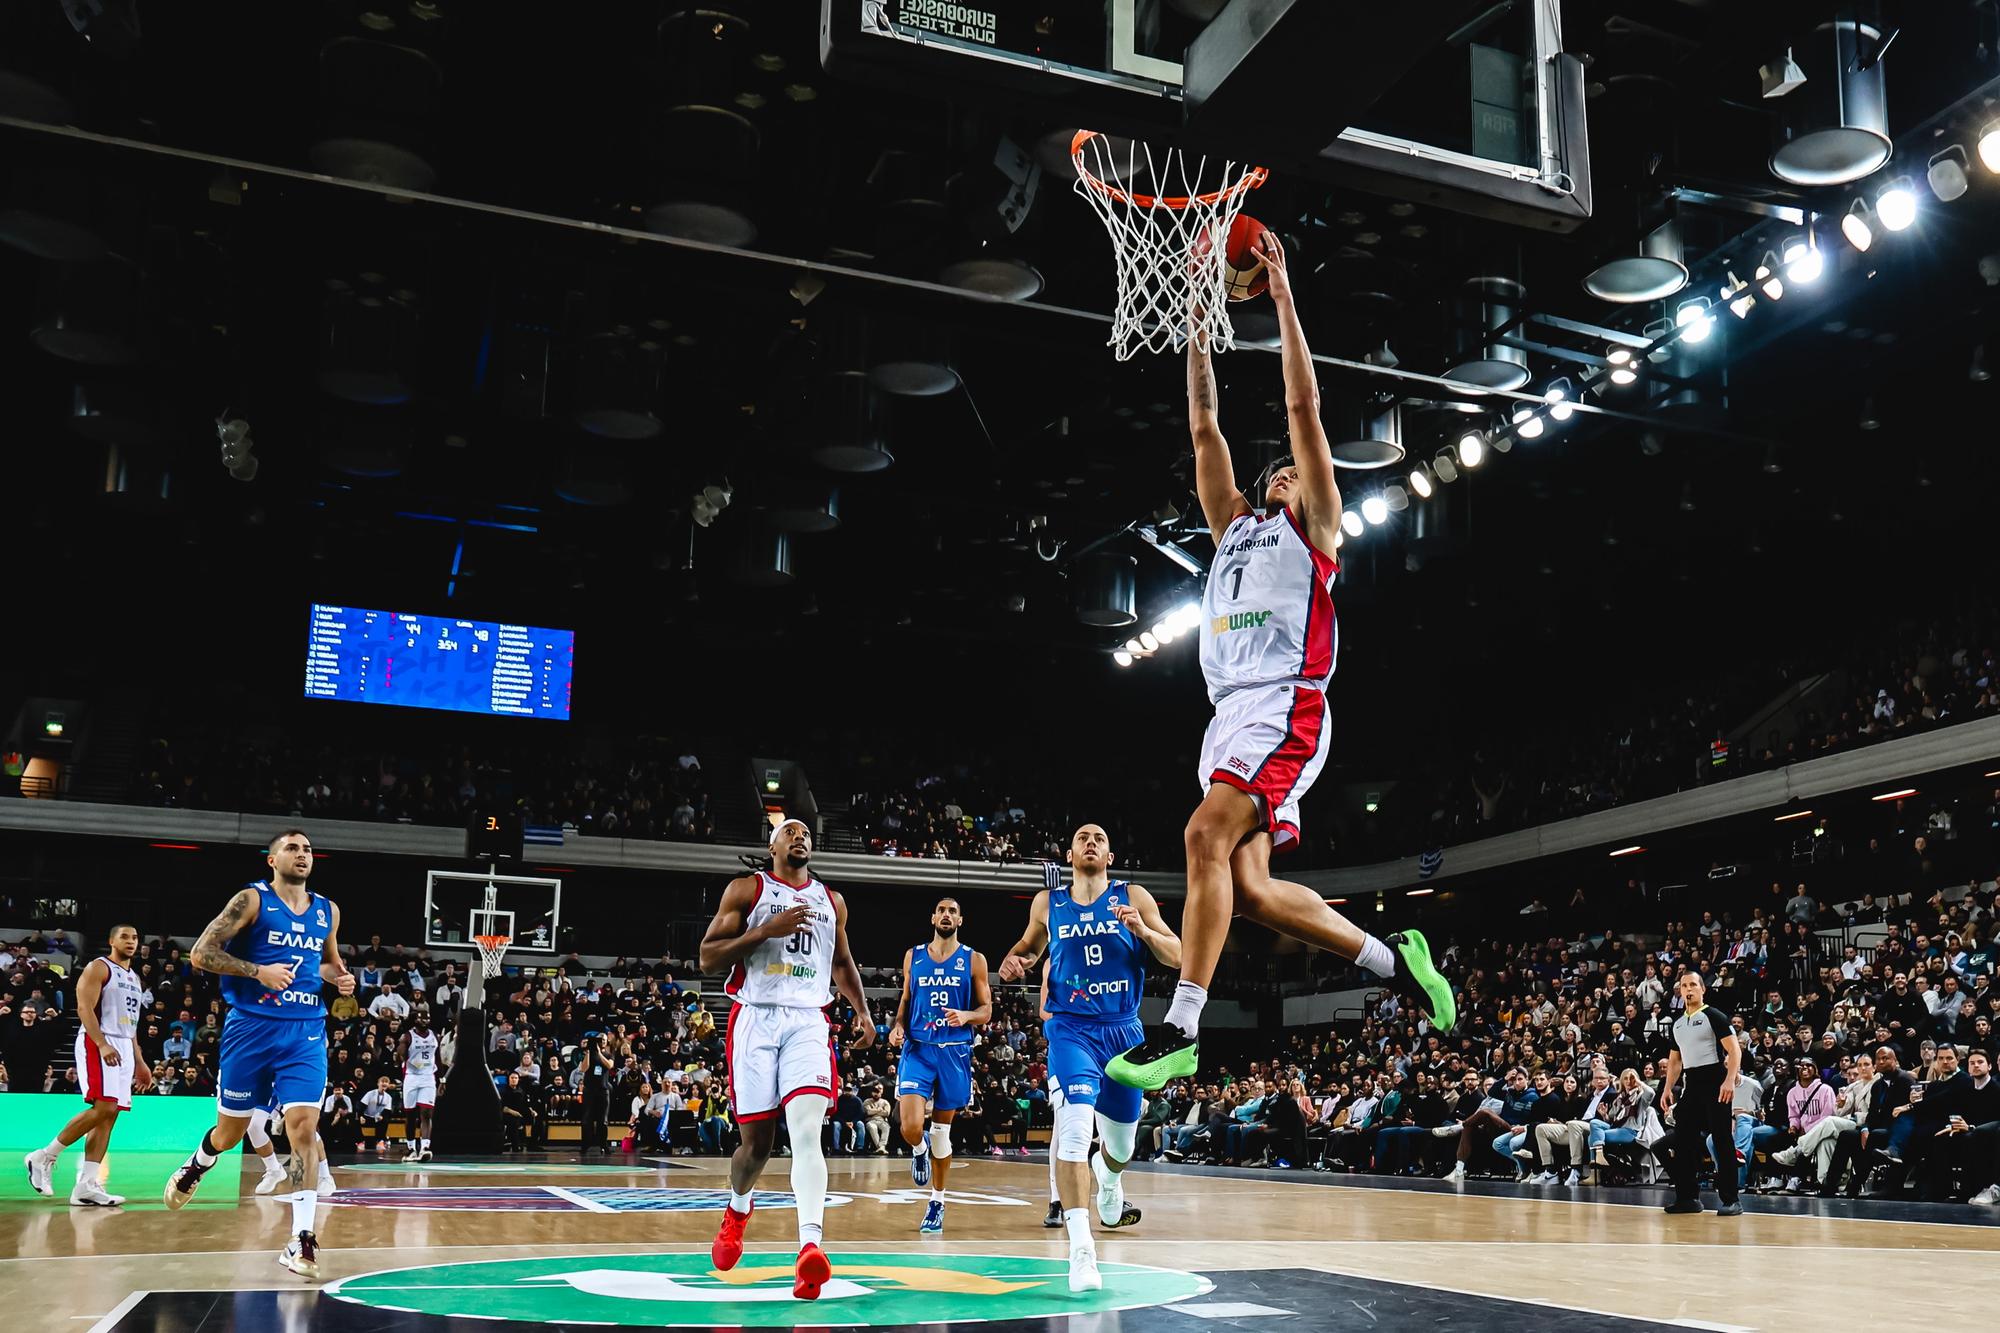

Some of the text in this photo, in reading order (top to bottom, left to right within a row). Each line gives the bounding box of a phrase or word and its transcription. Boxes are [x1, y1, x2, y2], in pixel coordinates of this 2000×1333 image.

[1232, 568, 1243, 600] 1
[406, 623, 421, 635] 44
[1211, 609, 1272, 634] BWAY
[441, 627, 449, 638] 3
[474, 629, 489, 642] 48
[407, 638, 415, 647] 2
[1058, 920, 1120, 939] ΕΛΛΑΣ
[267, 930, 324, 952] ΕΛΛΑΣ
[785, 931, 813, 956] 30
[1084, 944, 1103, 966] 19
[291, 955, 304, 975] 7
[918, 976, 961, 987] ΕΛΛΑΣ
[930, 991, 949, 1007] 29
